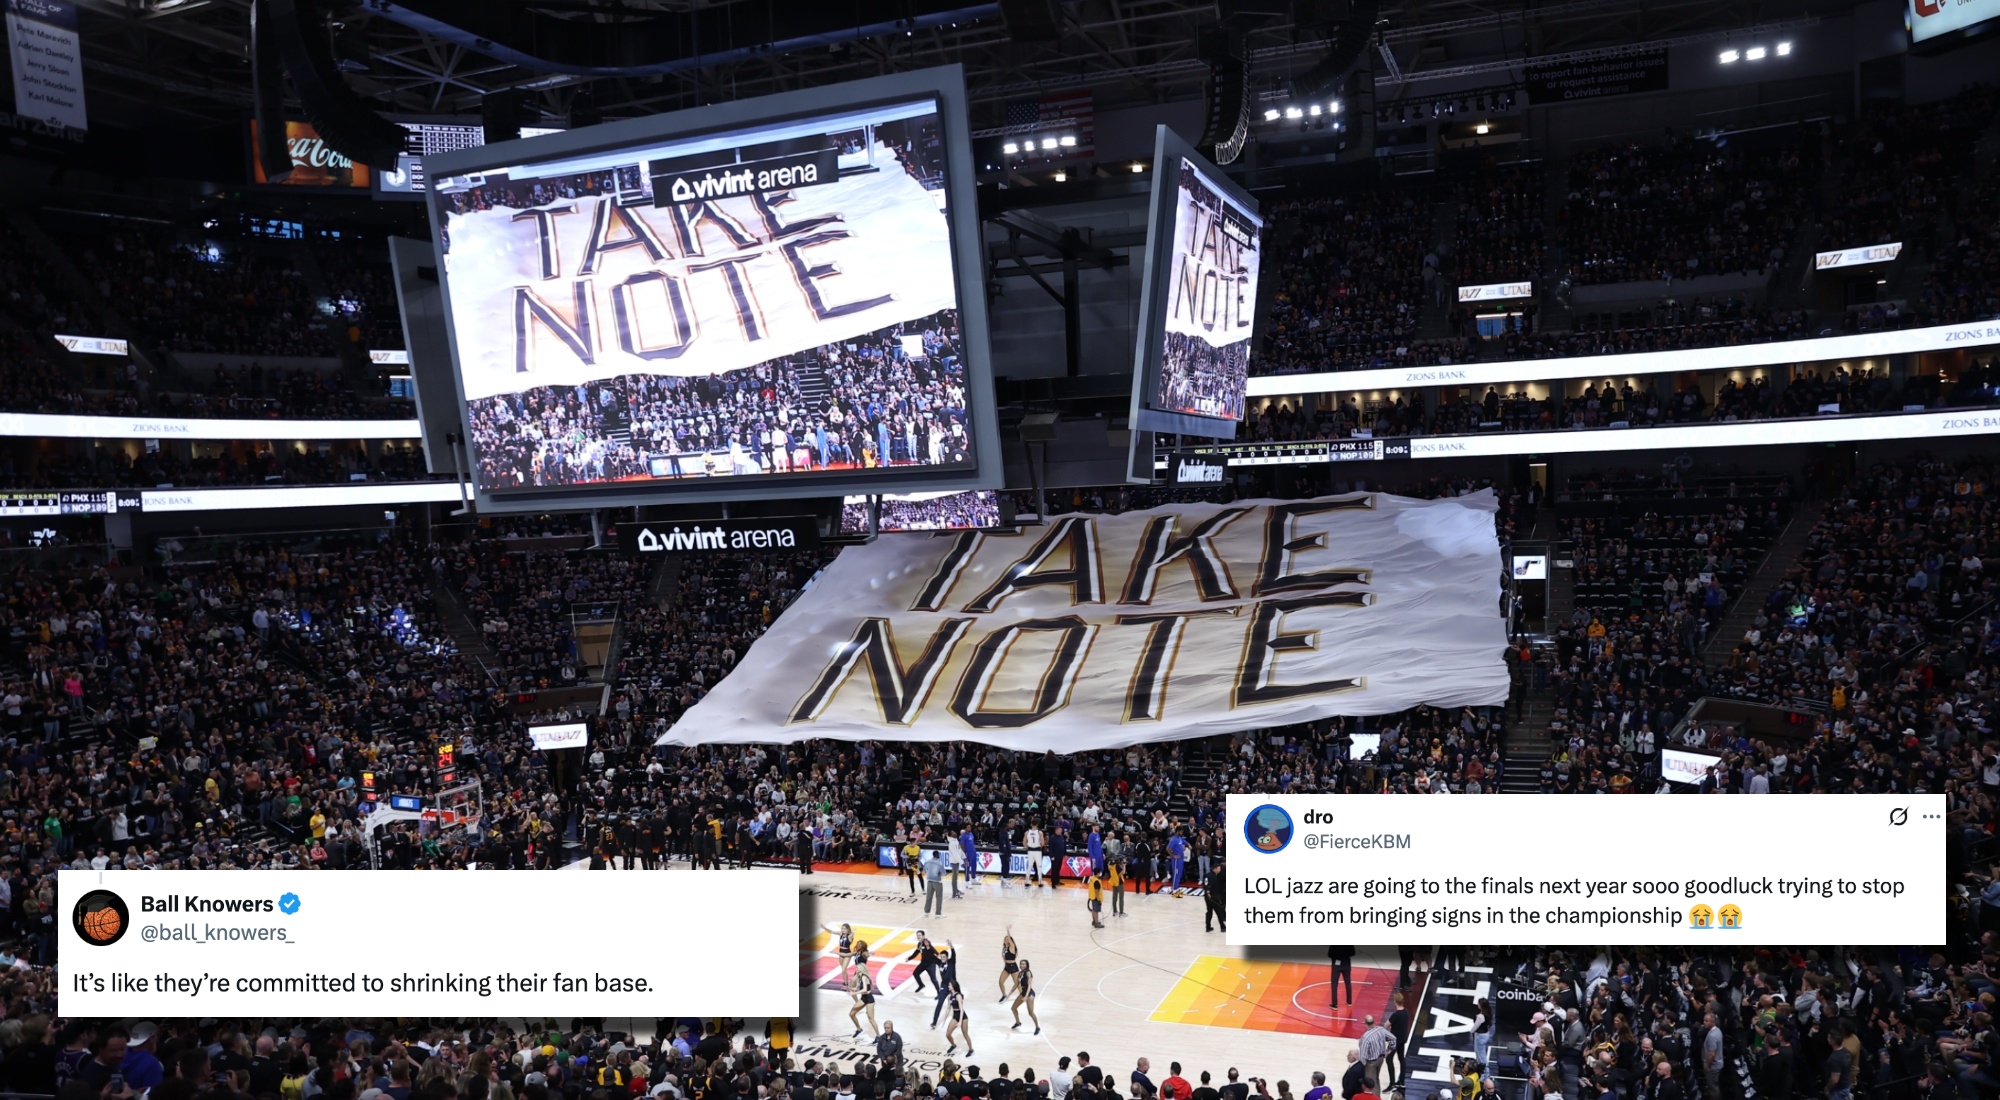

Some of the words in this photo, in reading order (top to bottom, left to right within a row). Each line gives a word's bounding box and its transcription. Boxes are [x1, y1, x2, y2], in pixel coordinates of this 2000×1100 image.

[21, 3, 48, 16] FAME
[48, 4, 62, 12] OF
[17, 24, 34, 36] Pete
[37, 29, 71, 45] Maravich
[18, 41, 43, 53] Adrian
[45, 48, 73, 63] Dantley
[27, 59, 46, 71] Jerry
[48, 64, 69, 76] Sloan
[1542, 67, 1571, 80] report
[1573, 61, 1633, 76] fan-behavior
[1636, 58, 1665, 68] issues
[22, 74, 41, 85] John
[43, 79, 76, 93] Stockton
[1560, 76, 1595, 88] request
[1598, 71, 1646, 83] assistance
[1603, 85, 1629, 95] arena
[28, 91, 44, 102] Karl
[47, 96, 73, 108] Malone
[693, 168, 754, 199] vivint
[758, 161, 818, 189] arena
[510, 187, 847, 281] TAKE
[1174, 253, 1250, 331] NOTE
[1459, 288, 1482, 300] JAZZ
[514, 230, 897, 373] NOTE
[1945, 329, 1983, 342] ZIONS
[1987, 327, 2000, 337] BA
[1406, 372, 1436, 381] ZIONS
[1438, 371, 1466, 379] BANK
[132, 424, 161, 432] ZIONS
[163, 424, 190, 432] BANK
[1942, 418, 1980, 429] ZIONS
[1984, 417, 2000, 427] BA
[1340, 443, 1356, 451] PHX
[1358, 442, 1373, 450] 115
[1385, 446, 1403, 454] 8:09
[1411, 444, 1436, 453] IONS
[1438, 443, 1466, 451] BANK
[1340, 452, 1357, 460] NOP
[1358, 451, 1373, 459] 109
[71, 494, 89, 502] PHX
[91, 493, 106, 502] 115
[118, 498, 135, 507] 8:09
[143, 498, 167, 506] IONS
[168, 497, 194, 505] BANK
[71, 503, 91, 512] NOP
[91, 503, 107, 512] 109
[660, 526, 728, 551] vivint
[731, 528, 796, 549] arena
[907, 496, 1376, 613] TAKE
[785, 590, 1377, 729] NOTE
[438, 753, 453, 768] 24
[853, 894, 918, 904] arena
[1497, 988, 1545, 1002] coinba
[910, 1048, 943, 1056] Court
